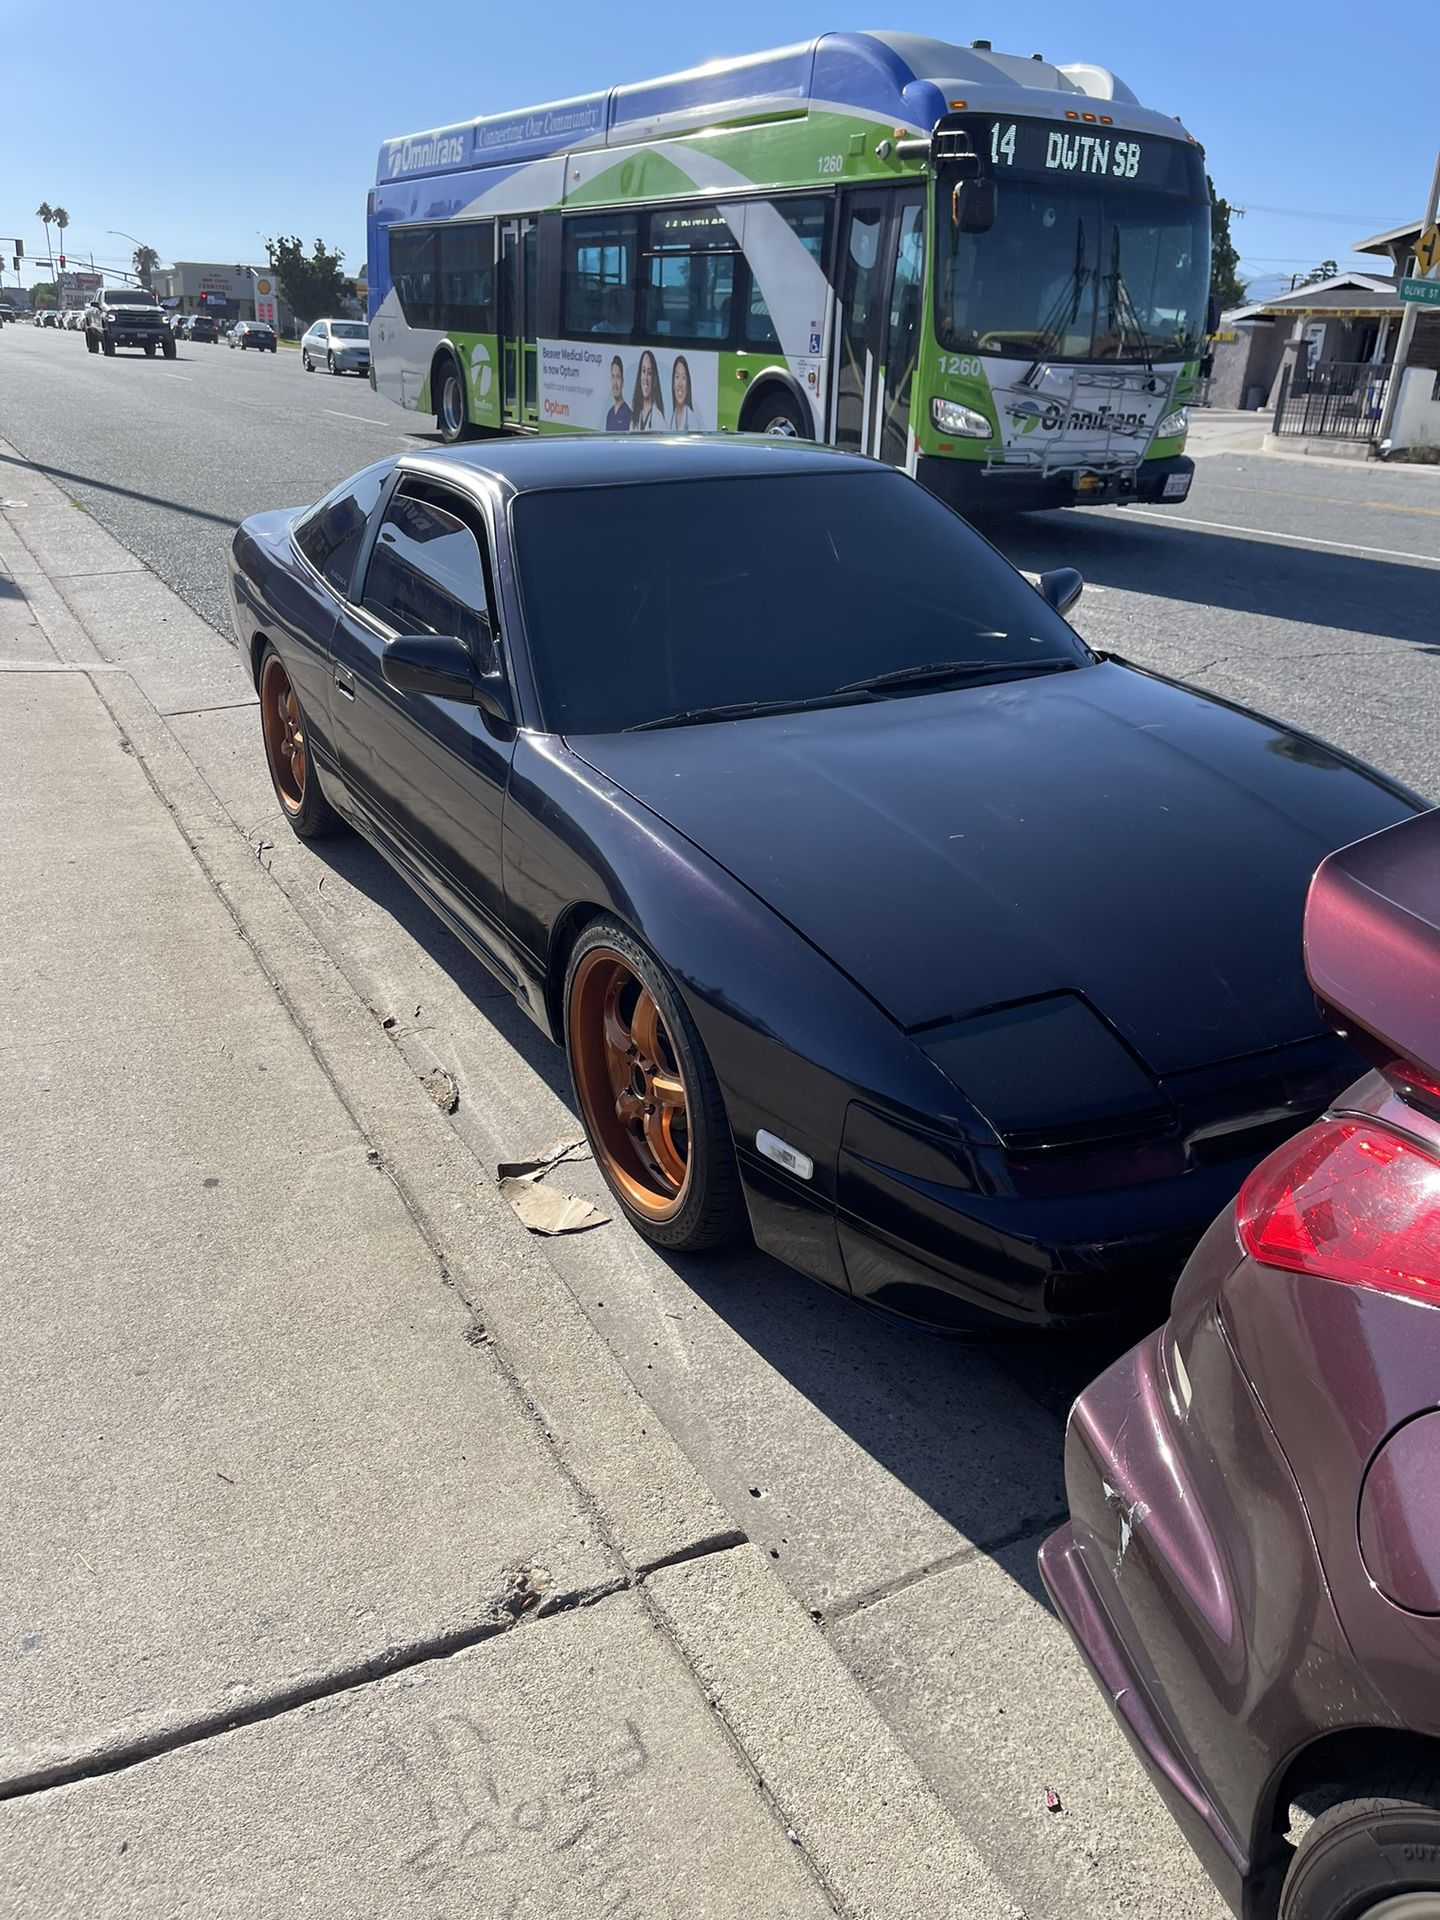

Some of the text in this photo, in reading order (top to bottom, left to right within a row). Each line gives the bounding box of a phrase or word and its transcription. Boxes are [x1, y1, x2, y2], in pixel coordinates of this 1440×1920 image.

[479, 108, 599, 147] Connecting Our Community
[991, 122, 1141, 178] 14 DWTN SB
[818, 155, 843, 173] 1260
[1404, 285, 1439, 298] OLIVE ST
[543, 348, 602, 366] Beaver Medical Group
[938, 355, 981, 377] 1260
[548, 364, 559, 376] now
[560, 365, 579, 378] Optum
[545, 399, 569, 416] Optum
